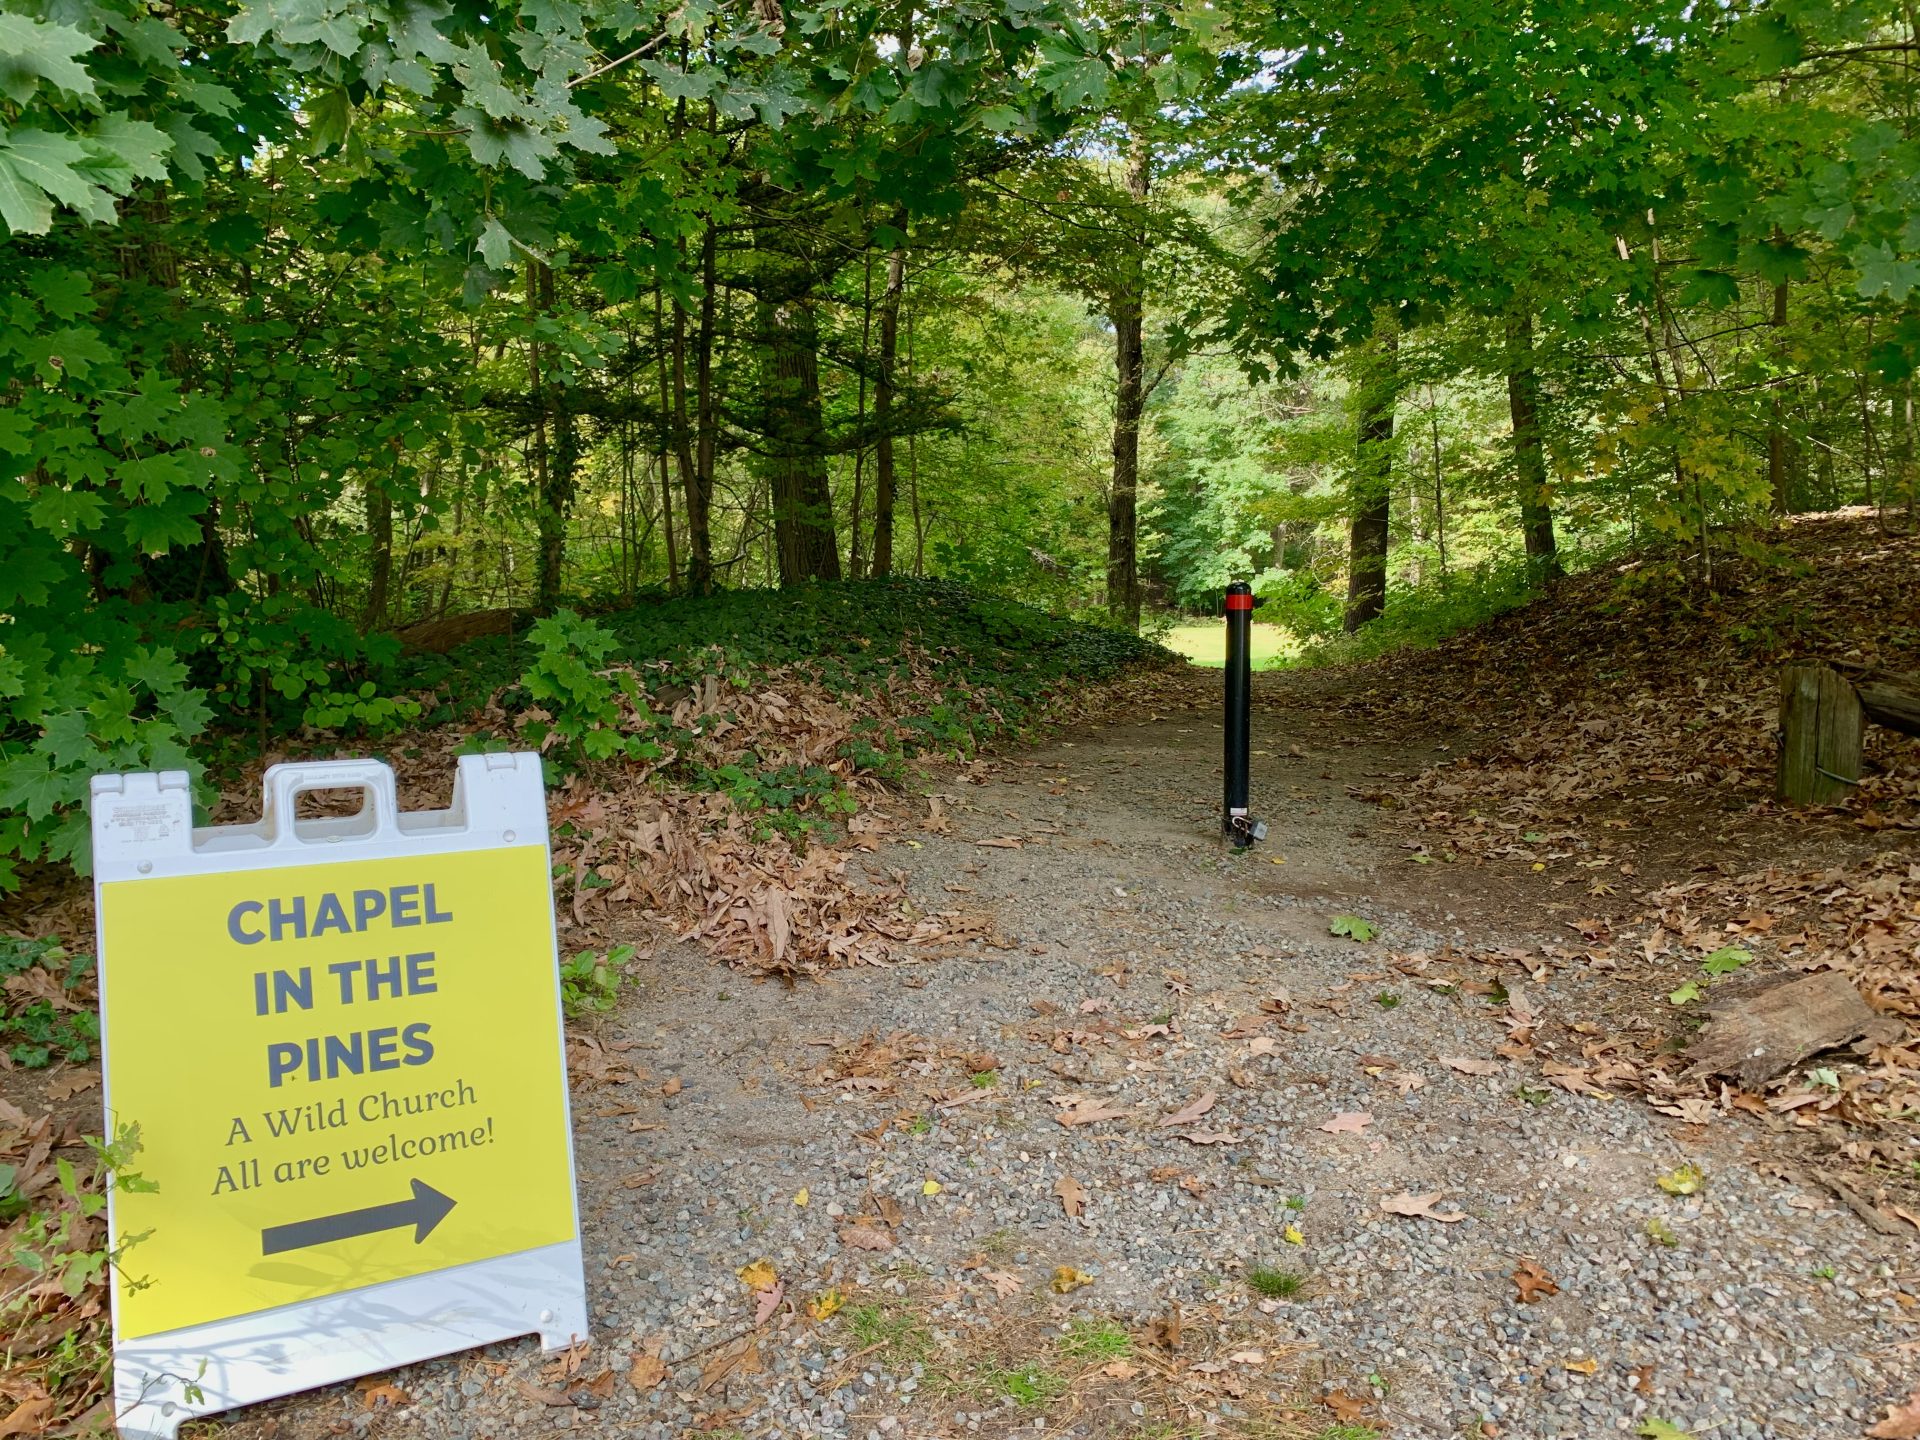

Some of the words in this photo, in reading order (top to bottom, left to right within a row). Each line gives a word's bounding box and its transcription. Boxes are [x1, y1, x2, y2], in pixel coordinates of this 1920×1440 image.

[227, 883, 454, 946] CHAPEL
[253, 967, 314, 1017] IN
[328, 952, 438, 1005] THE
[267, 1023, 435, 1089] PINES
[224, 1117, 253, 1147] A
[262, 1097, 349, 1138] Wild
[358, 1078, 478, 1122] Church
[210, 1158, 263, 1196] All
[273, 1155, 331, 1184] are
[340, 1116, 494, 1171] welcome!
